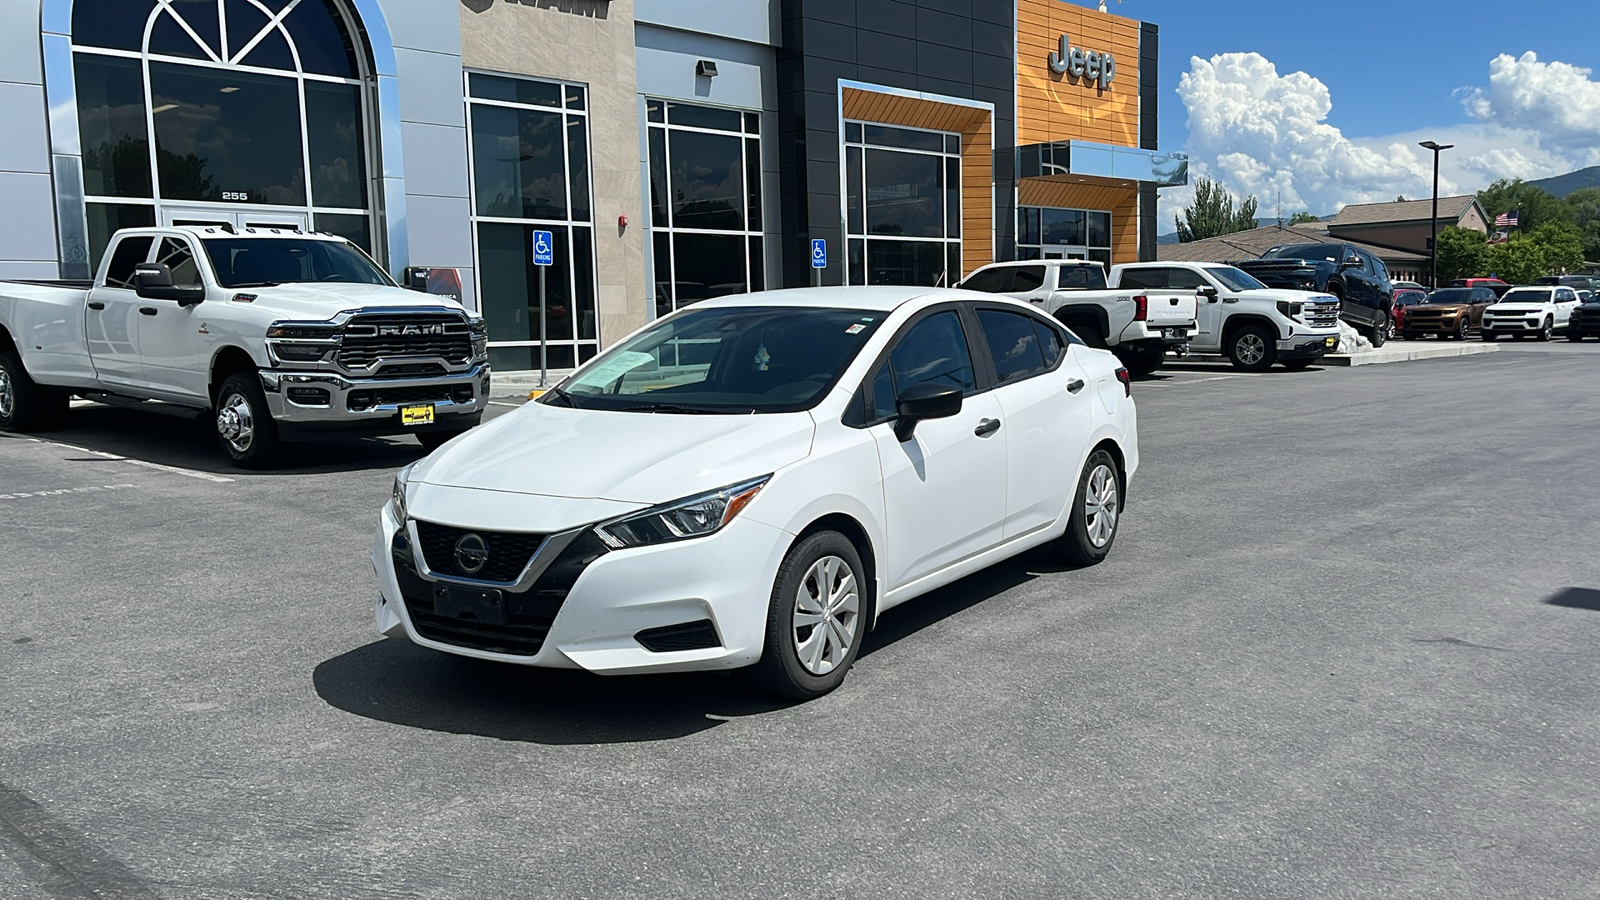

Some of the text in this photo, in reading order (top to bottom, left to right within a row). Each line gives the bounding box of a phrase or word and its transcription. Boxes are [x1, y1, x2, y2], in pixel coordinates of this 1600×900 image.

[1048, 34, 1116, 88] Jeep
[222, 192, 248, 200] 255
[379, 325, 442, 335] RAM
